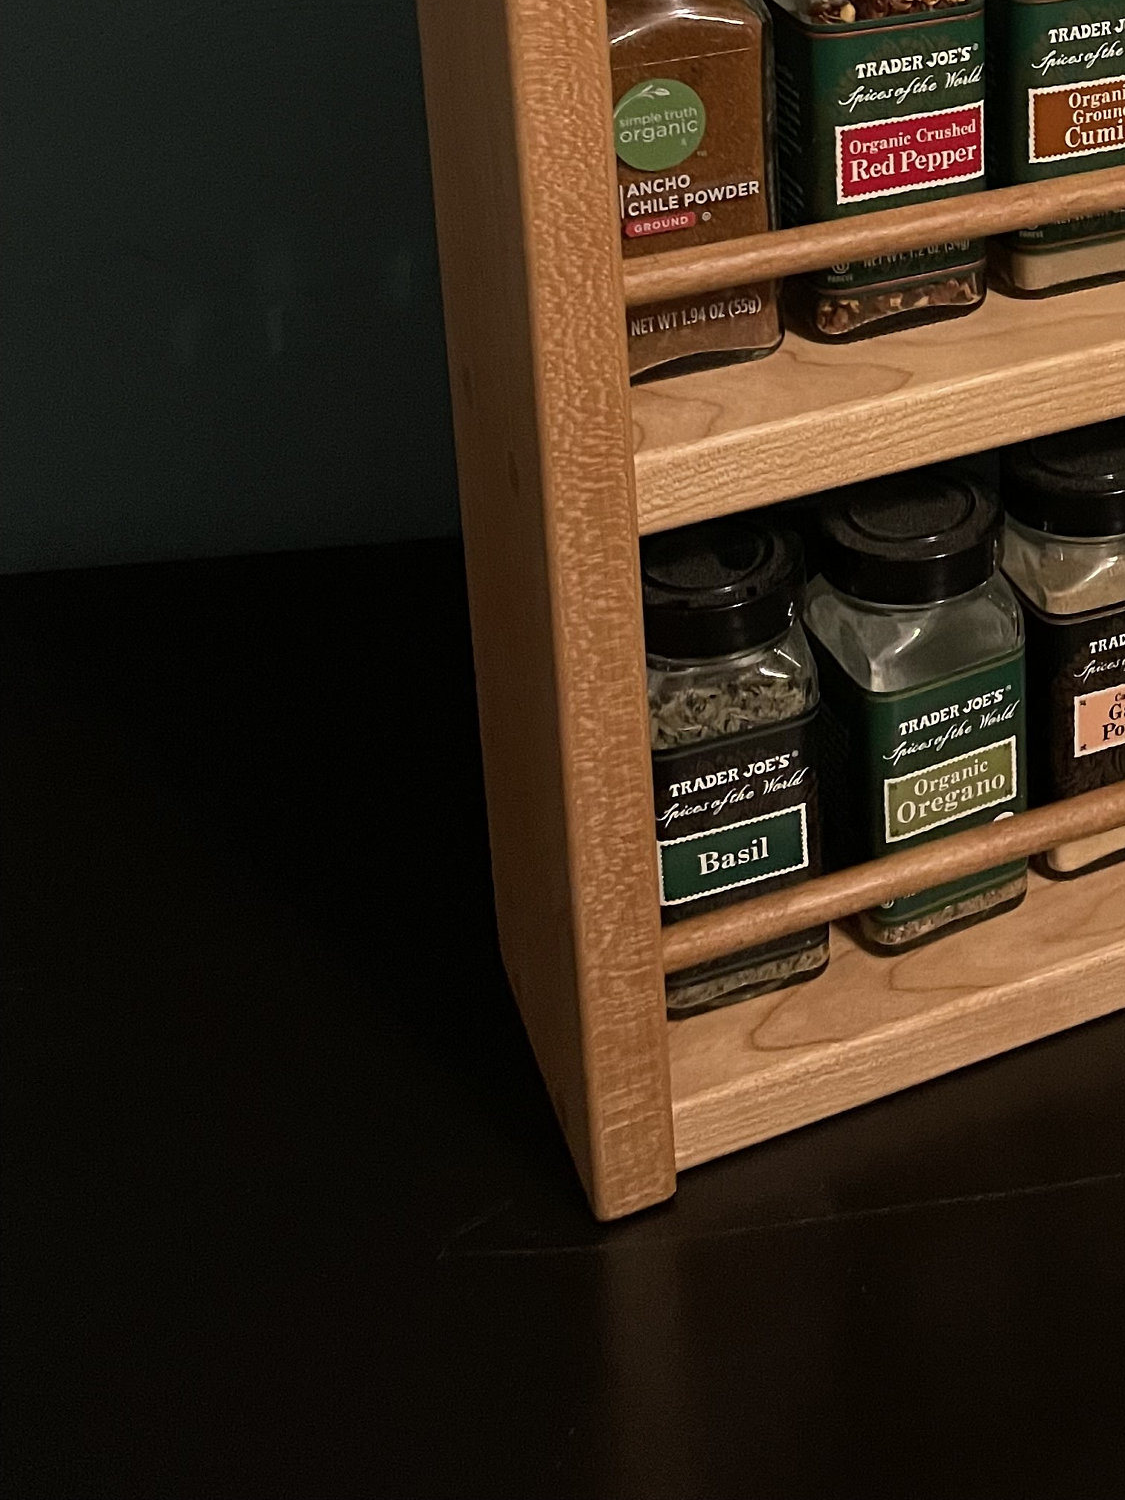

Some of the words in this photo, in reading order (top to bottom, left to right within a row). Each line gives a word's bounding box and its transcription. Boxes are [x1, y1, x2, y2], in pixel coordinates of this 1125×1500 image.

[1048, 21, 1112, 44] TRADER
[855, 55, 924, 79] TRADER
[926, 46, 972, 68] JOE'S
[1031, 49, 1083, 76] Spices
[1084, 42, 1106, 68] of
[1101, 40, 1124, 58] the
[838, 85, 894, 113] Spices
[894, 78, 920, 104] of
[914, 75, 938, 93] the
[944, 63, 984, 90] World
[619, 111, 662, 128] simple
[664, 106, 698, 121] truth
[620, 119, 698, 143] organic
[849, 132, 911, 155] Organic
[916, 118, 977, 143] Crushed
[849, 153, 896, 183] Red
[900, 145, 977, 173] Pepper
[627, 174, 691, 198] ANCHO
[628, 194, 680, 217] CHILE
[684, 180, 760, 207] POWDER
[633, 215, 689, 233] GROUND
[631, 316, 654, 336] NET
[657, 312, 678, 330] WT
[681, 306, 706, 326] 1.94
[709, 301, 726, 319] OZ
[728, 294, 762, 318] (55g)
[1073, 657, 1120, 683] Spices
[899, 705, 960, 736] TRADER
[963, 688, 1005, 713] JOE'S
[882, 740, 934, 766] Spices
[934, 724, 955, 751] of
[950, 719, 972, 740] the
[979, 699, 1020, 730] World
[669, 768, 740, 798] TRADER
[743, 753, 791, 778] JOE'S
[914, 758, 989, 796] Organic
[656, 802, 710, 829] Spices
[711, 788, 736, 816] of
[730, 784, 755, 804] the
[762, 767, 810, 796] World
[896, 773, 1006, 824] Oregano
[697, 836, 769, 875] Basil
